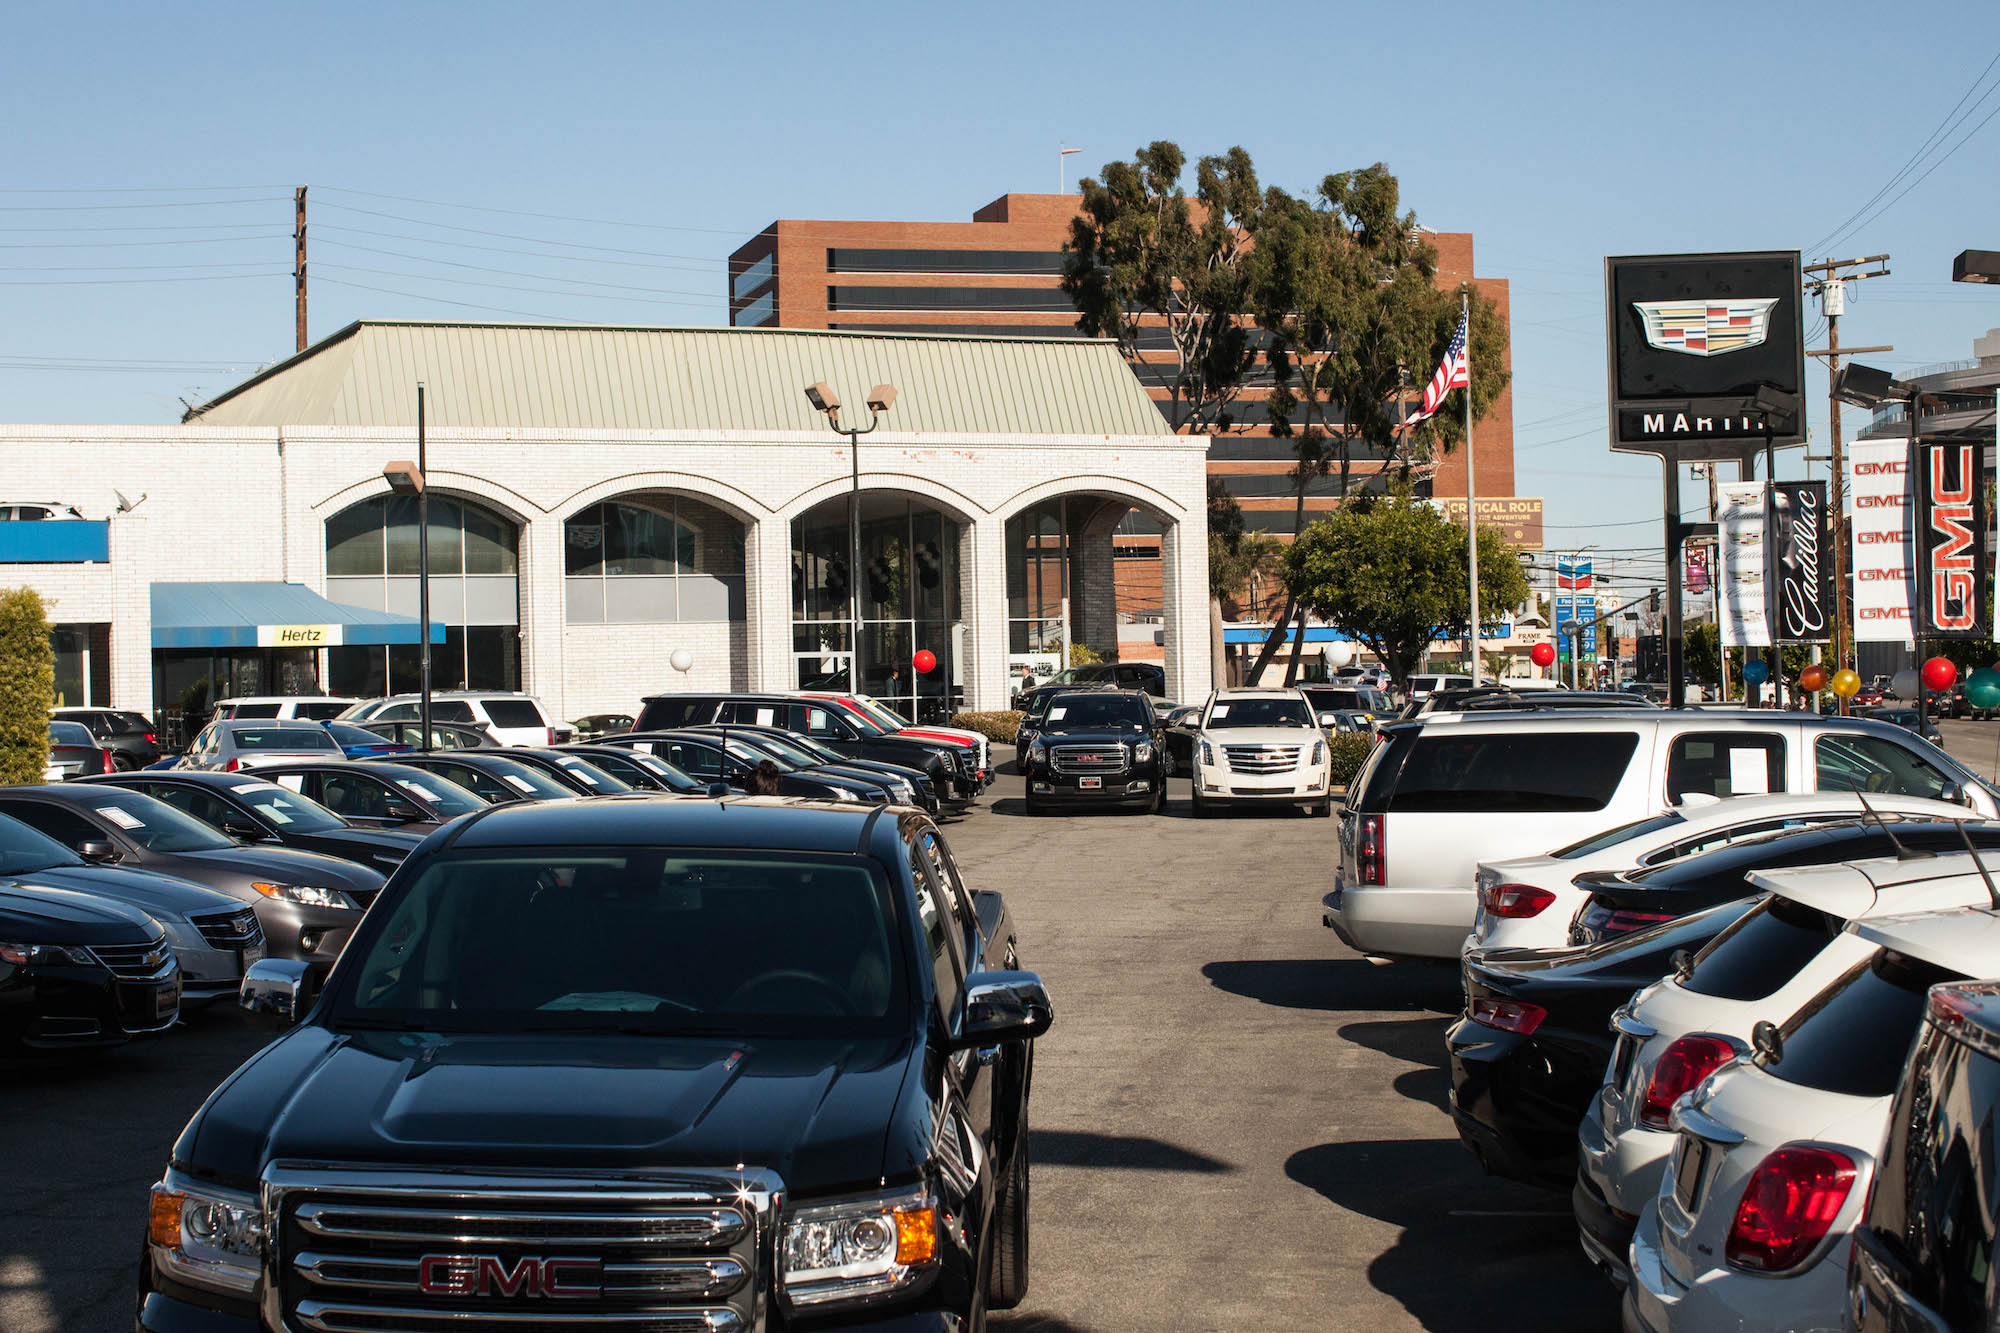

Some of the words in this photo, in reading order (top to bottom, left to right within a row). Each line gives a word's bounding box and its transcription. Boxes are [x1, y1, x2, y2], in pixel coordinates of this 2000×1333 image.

[1643, 412, 1765, 433] MARI
[1855, 461, 1910, 475] GMC
[1450, 502, 1506, 513] CRICAL
[1509, 502, 1541, 513] ROLE
[1856, 494, 1911, 508] GMC
[1722, 509, 1766, 522] Cadillac
[1857, 530, 1913, 544] GMC
[1930, 445, 1975, 631] GMC
[1723, 549, 1768, 561] Cadillac
[1784, 489, 1824, 637] Cadillac
[1858, 568, 1913, 581] GMC
[1725, 587, 1769, 600] Cadillac
[1859, 607, 1914, 620] GMC
[281, 629, 321, 641] Hertz
[1727, 625, 1767, 637] Cadi
[419, 1253, 602, 1298] GMC
